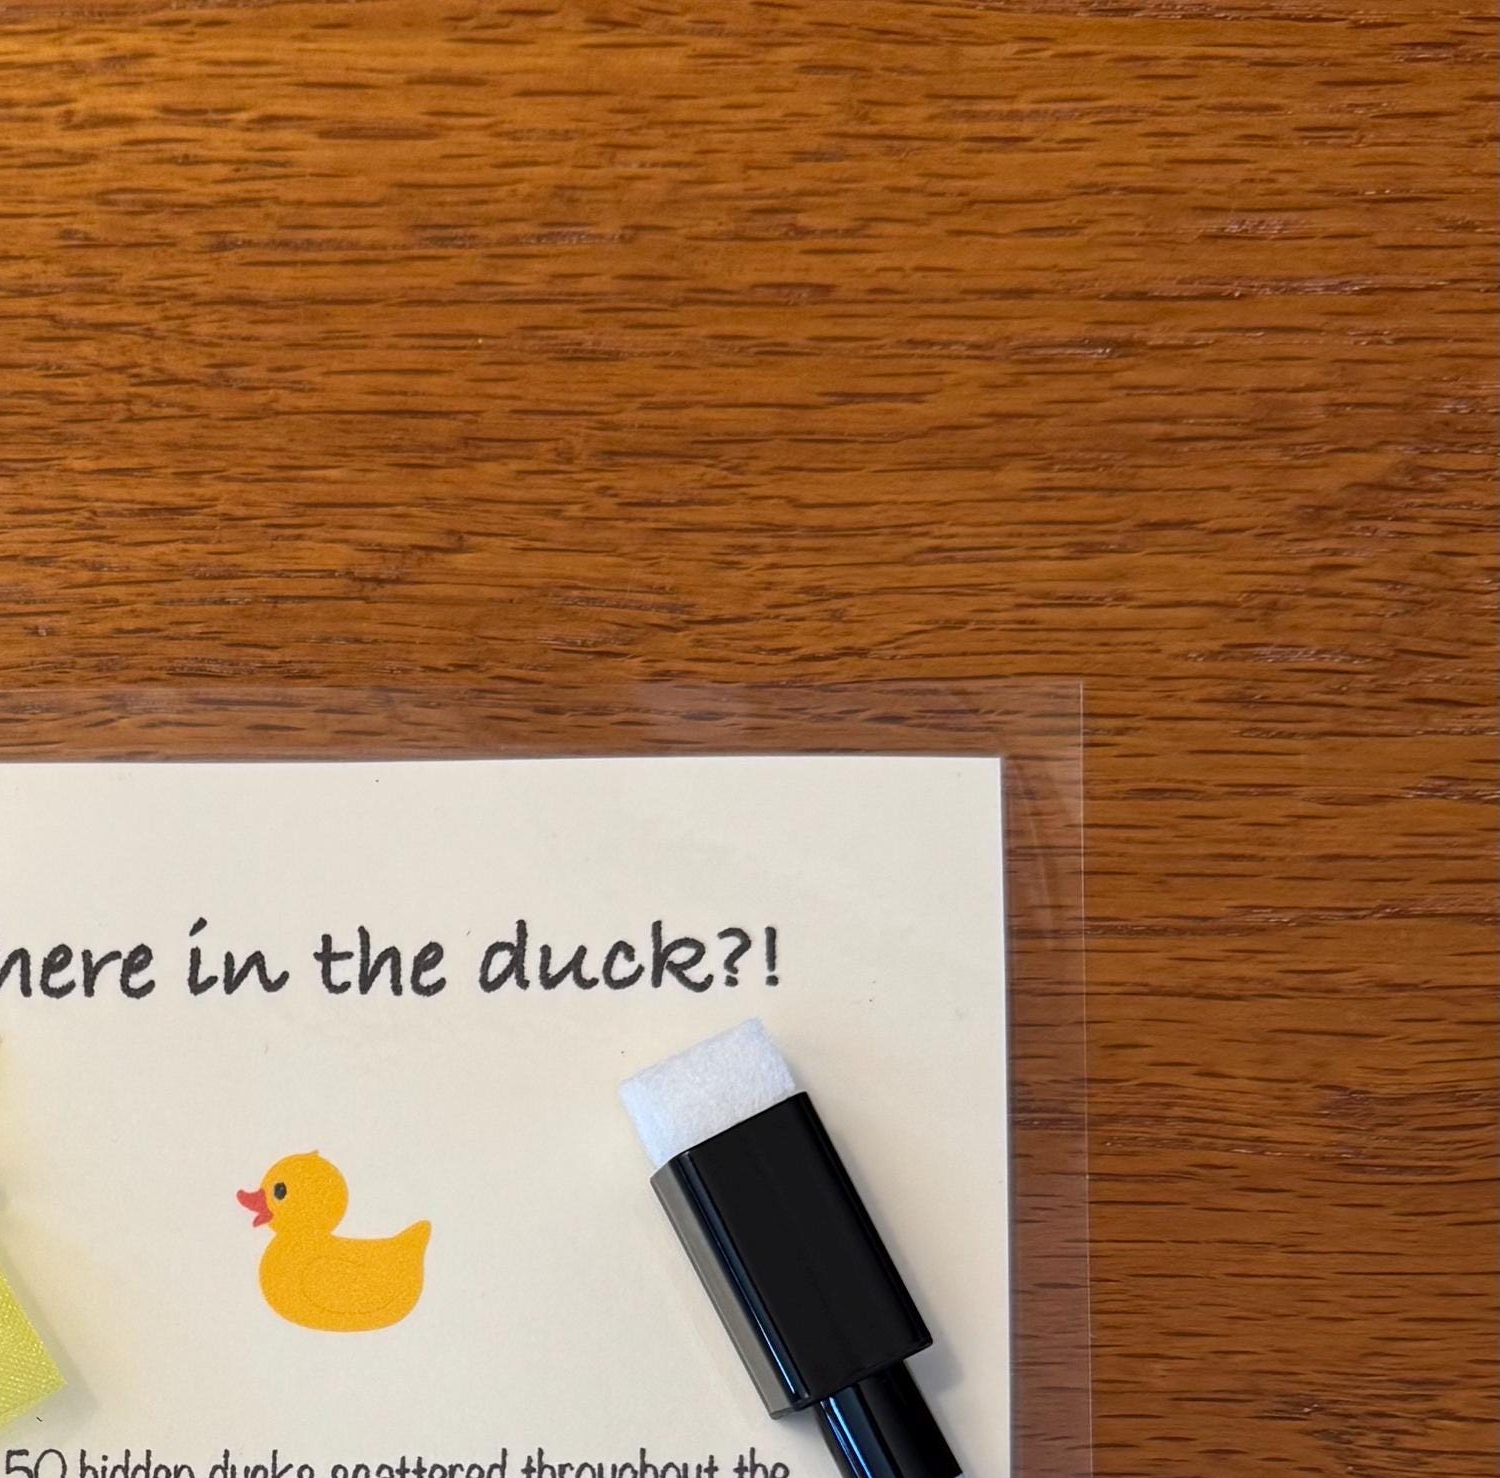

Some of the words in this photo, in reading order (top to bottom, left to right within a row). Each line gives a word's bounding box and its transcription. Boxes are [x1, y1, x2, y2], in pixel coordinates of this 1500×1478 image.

[187, 917, 288, 996] in
[313, 925, 446, 997] the
[479, 919, 779, 993] duck?!
